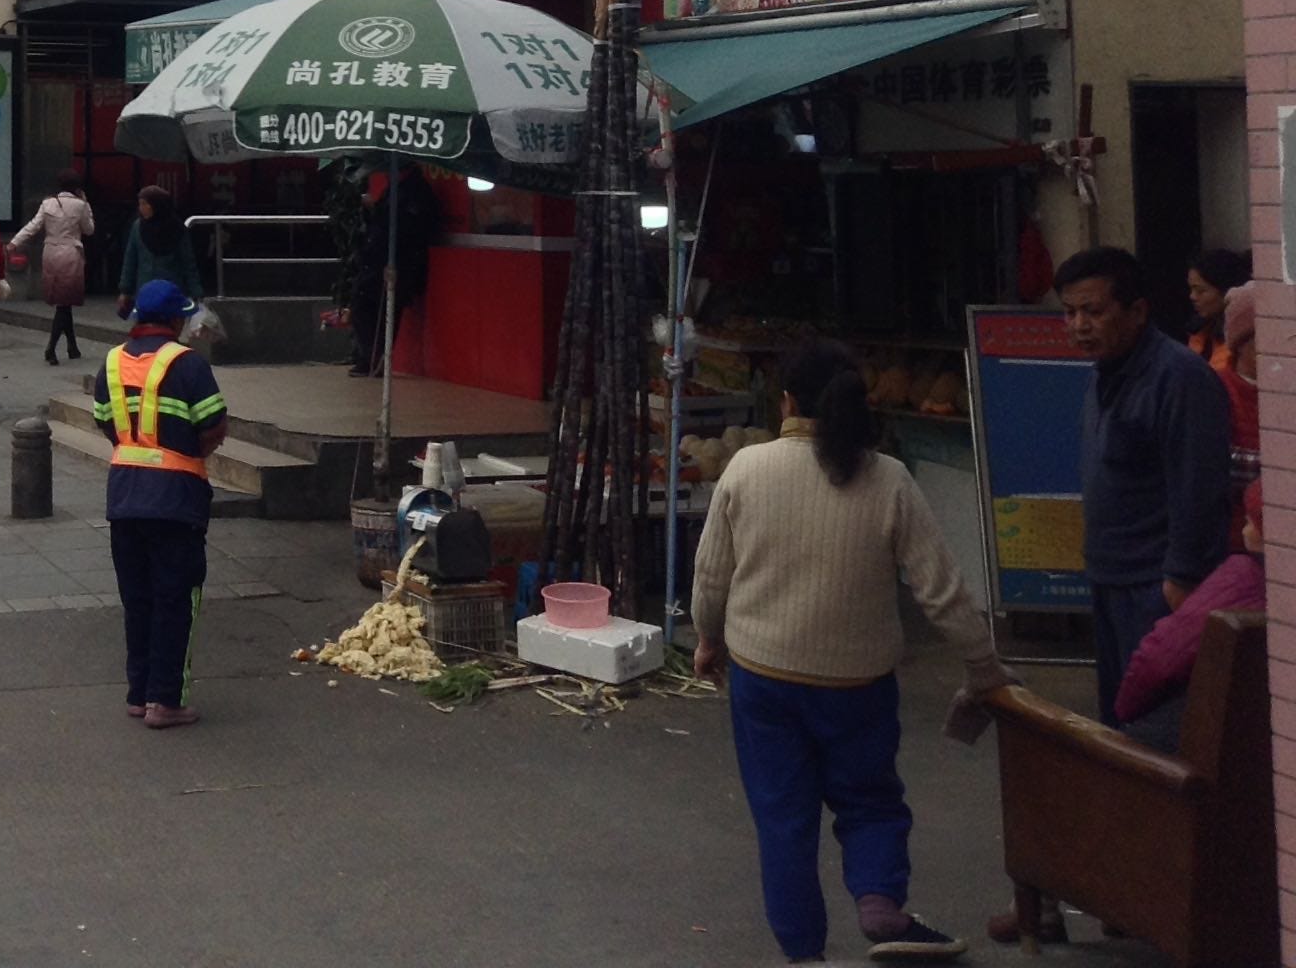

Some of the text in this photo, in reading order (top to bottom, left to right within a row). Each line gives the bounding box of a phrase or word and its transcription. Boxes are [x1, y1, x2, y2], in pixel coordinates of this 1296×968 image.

[285, 59, 457, 89] 尚孔教育
[283, 109, 445, 150] 400-621-5553
